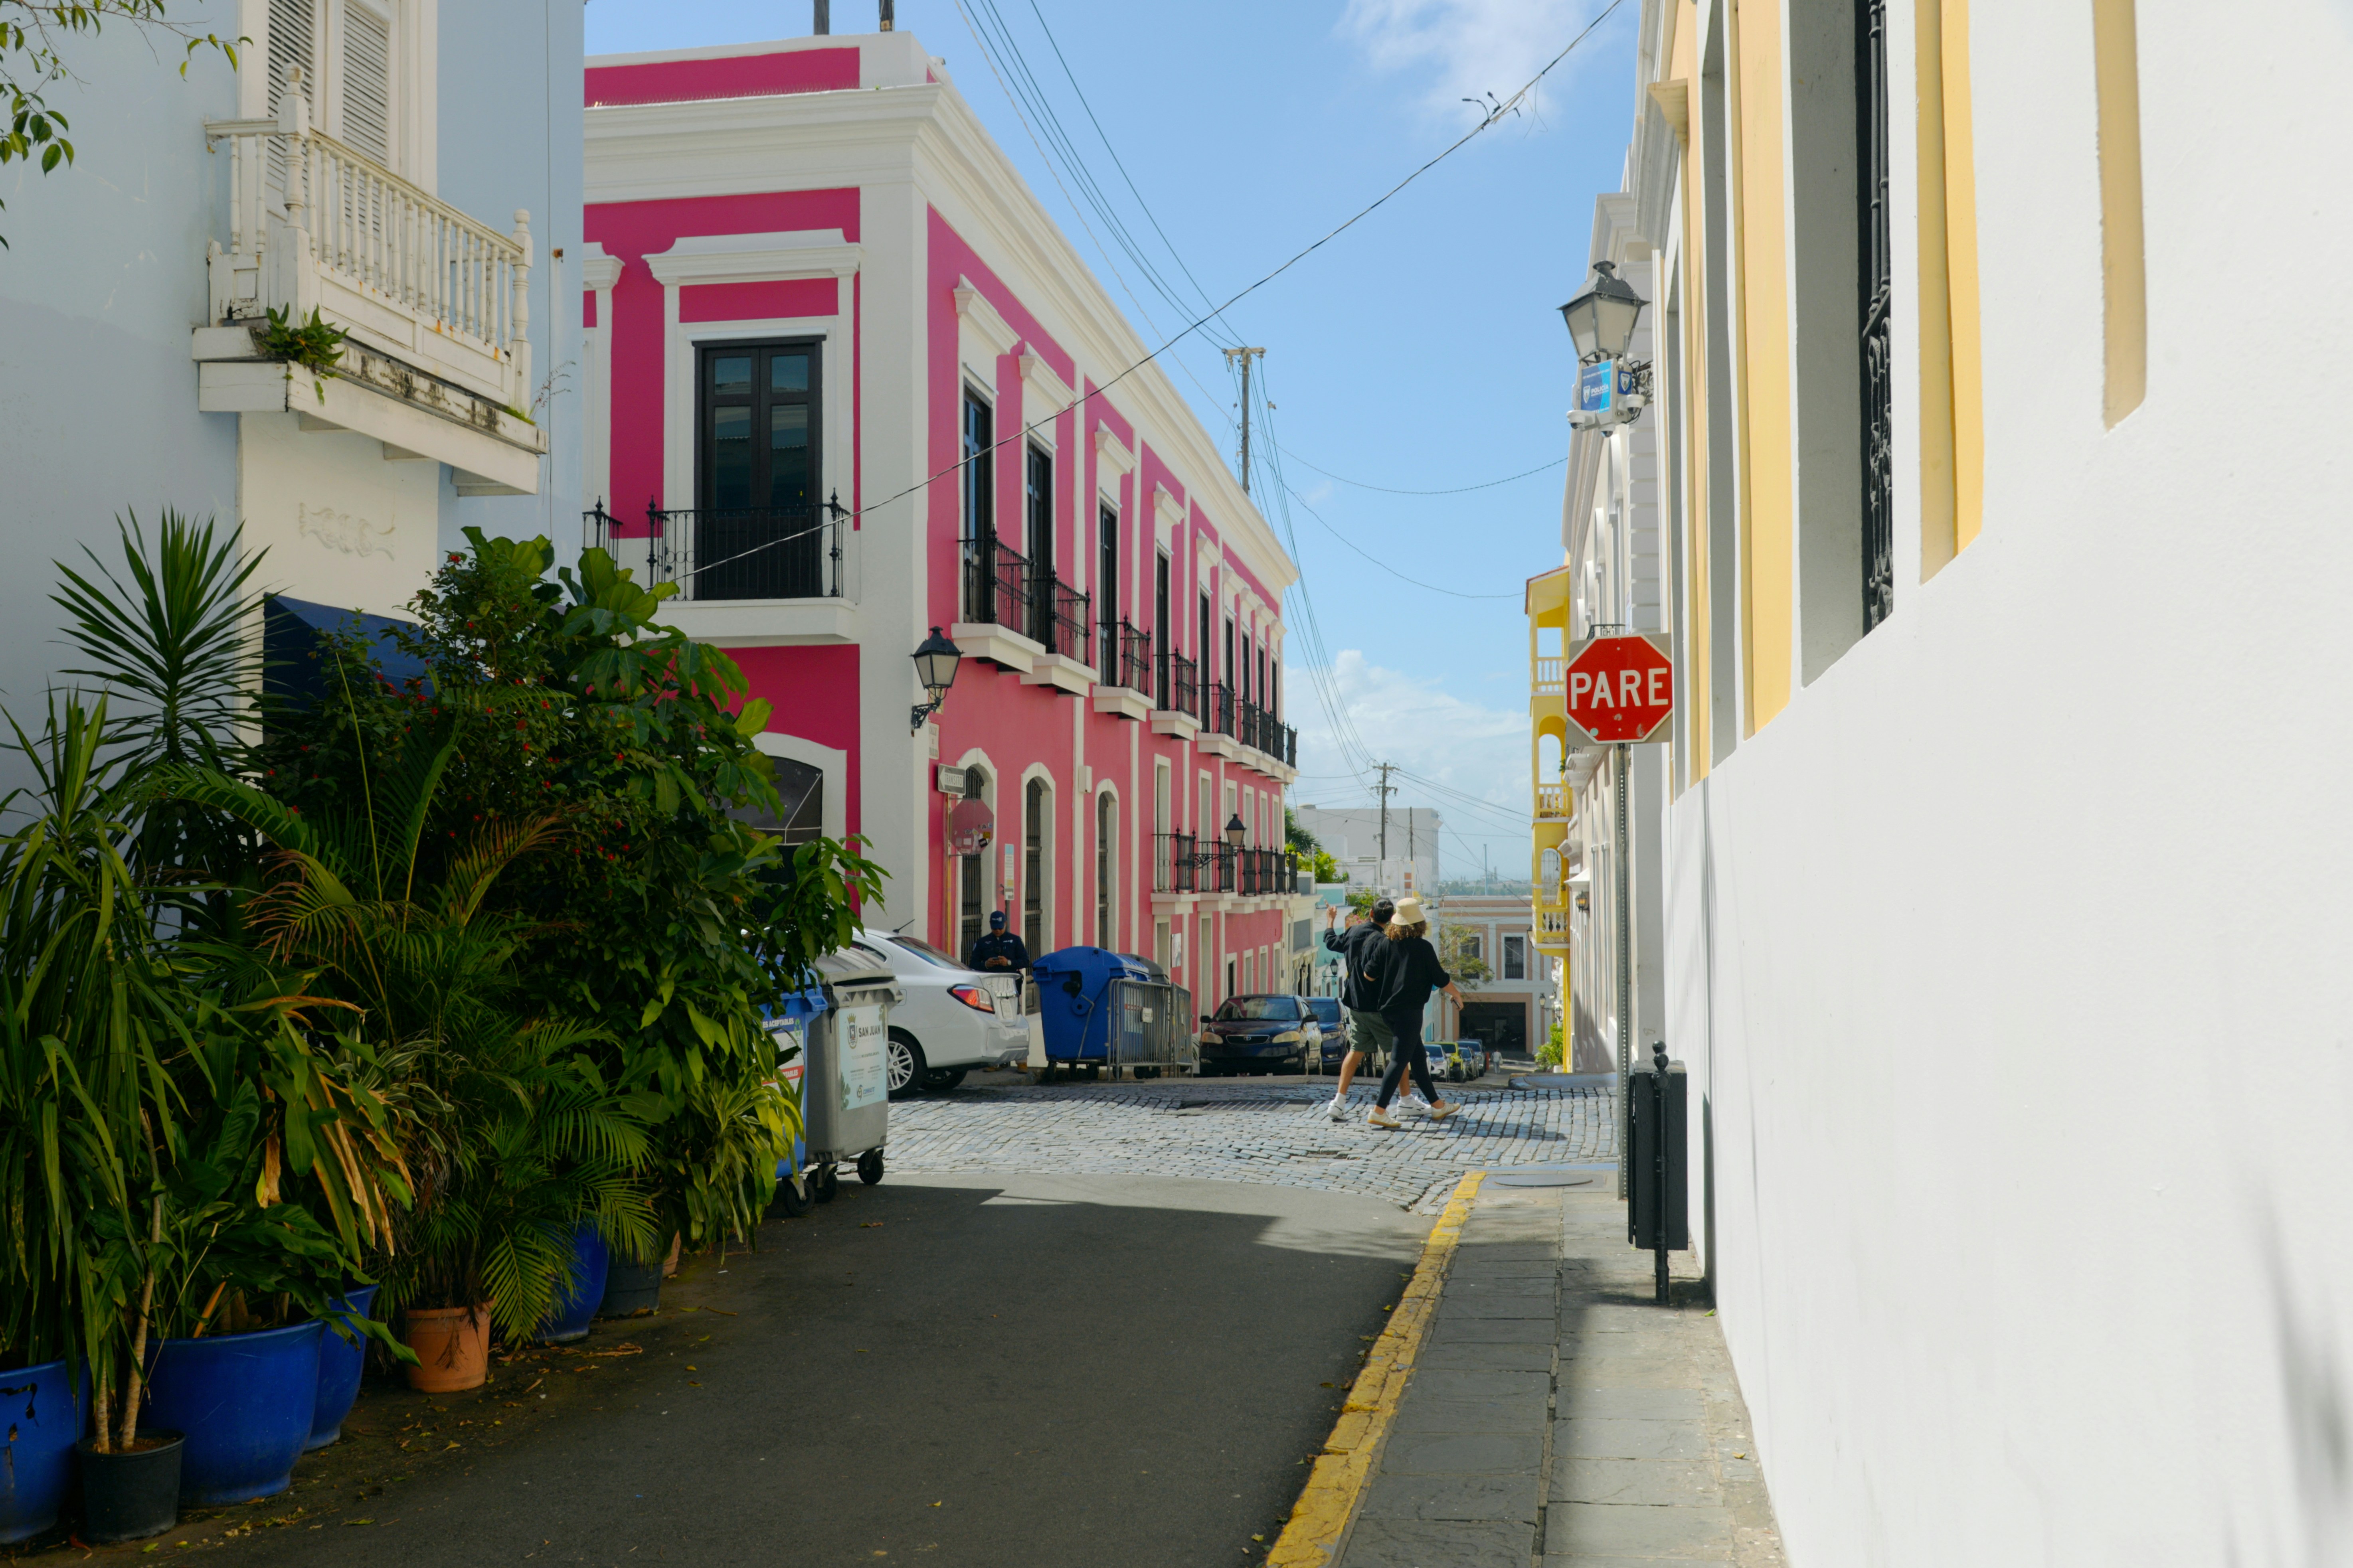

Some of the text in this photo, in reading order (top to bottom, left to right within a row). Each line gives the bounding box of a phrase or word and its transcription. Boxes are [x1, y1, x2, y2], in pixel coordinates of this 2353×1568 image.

[1591, 383, 1609, 394] POLICÍA
[1571, 667, 1669, 710] PARE
[945, 774, 962, 786] TRANSITO
[769, 1018, 794, 1028] ACEPTABLES
[858, 1025, 880, 1037] SAN JUAN
[783, 1069, 798, 1078] TABLES
